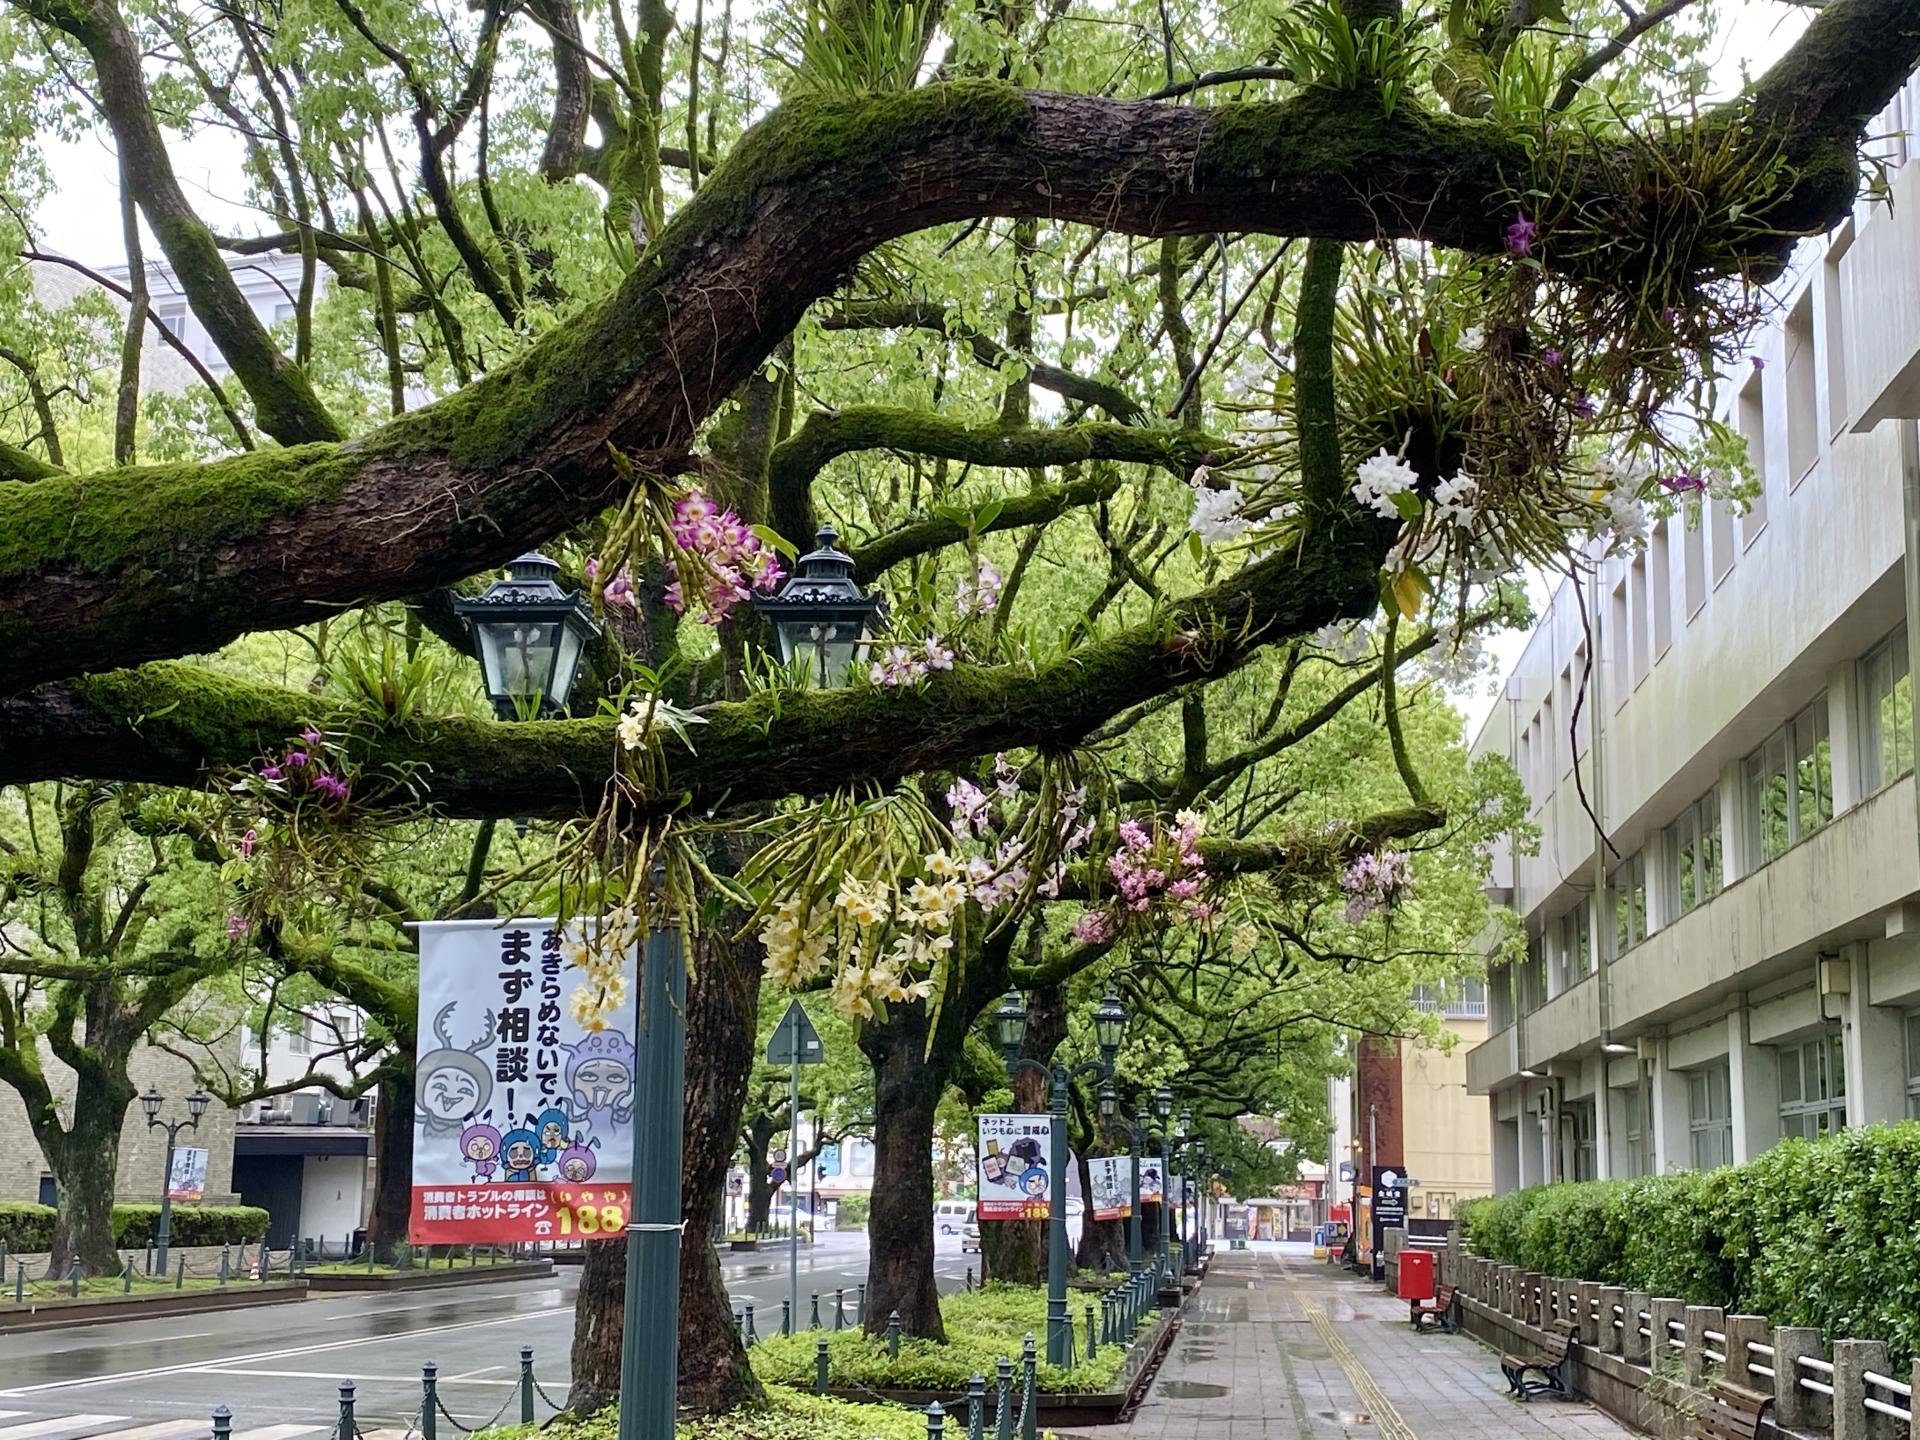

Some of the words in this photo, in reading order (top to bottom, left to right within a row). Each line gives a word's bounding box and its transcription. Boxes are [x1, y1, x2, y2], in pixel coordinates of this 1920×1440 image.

[535, 929, 563, 1095] あきらめないで
[496, 929, 534, 1121] まず相談！
[982, 1118, 1014, 1126] ネット上
[424, 1204, 549, 1221] 消費者ホットライン
[555, 1205, 624, 1235] 188
[1025, 1207, 1050, 1219] 188
[1328, 1224, 1335, 1236] P
